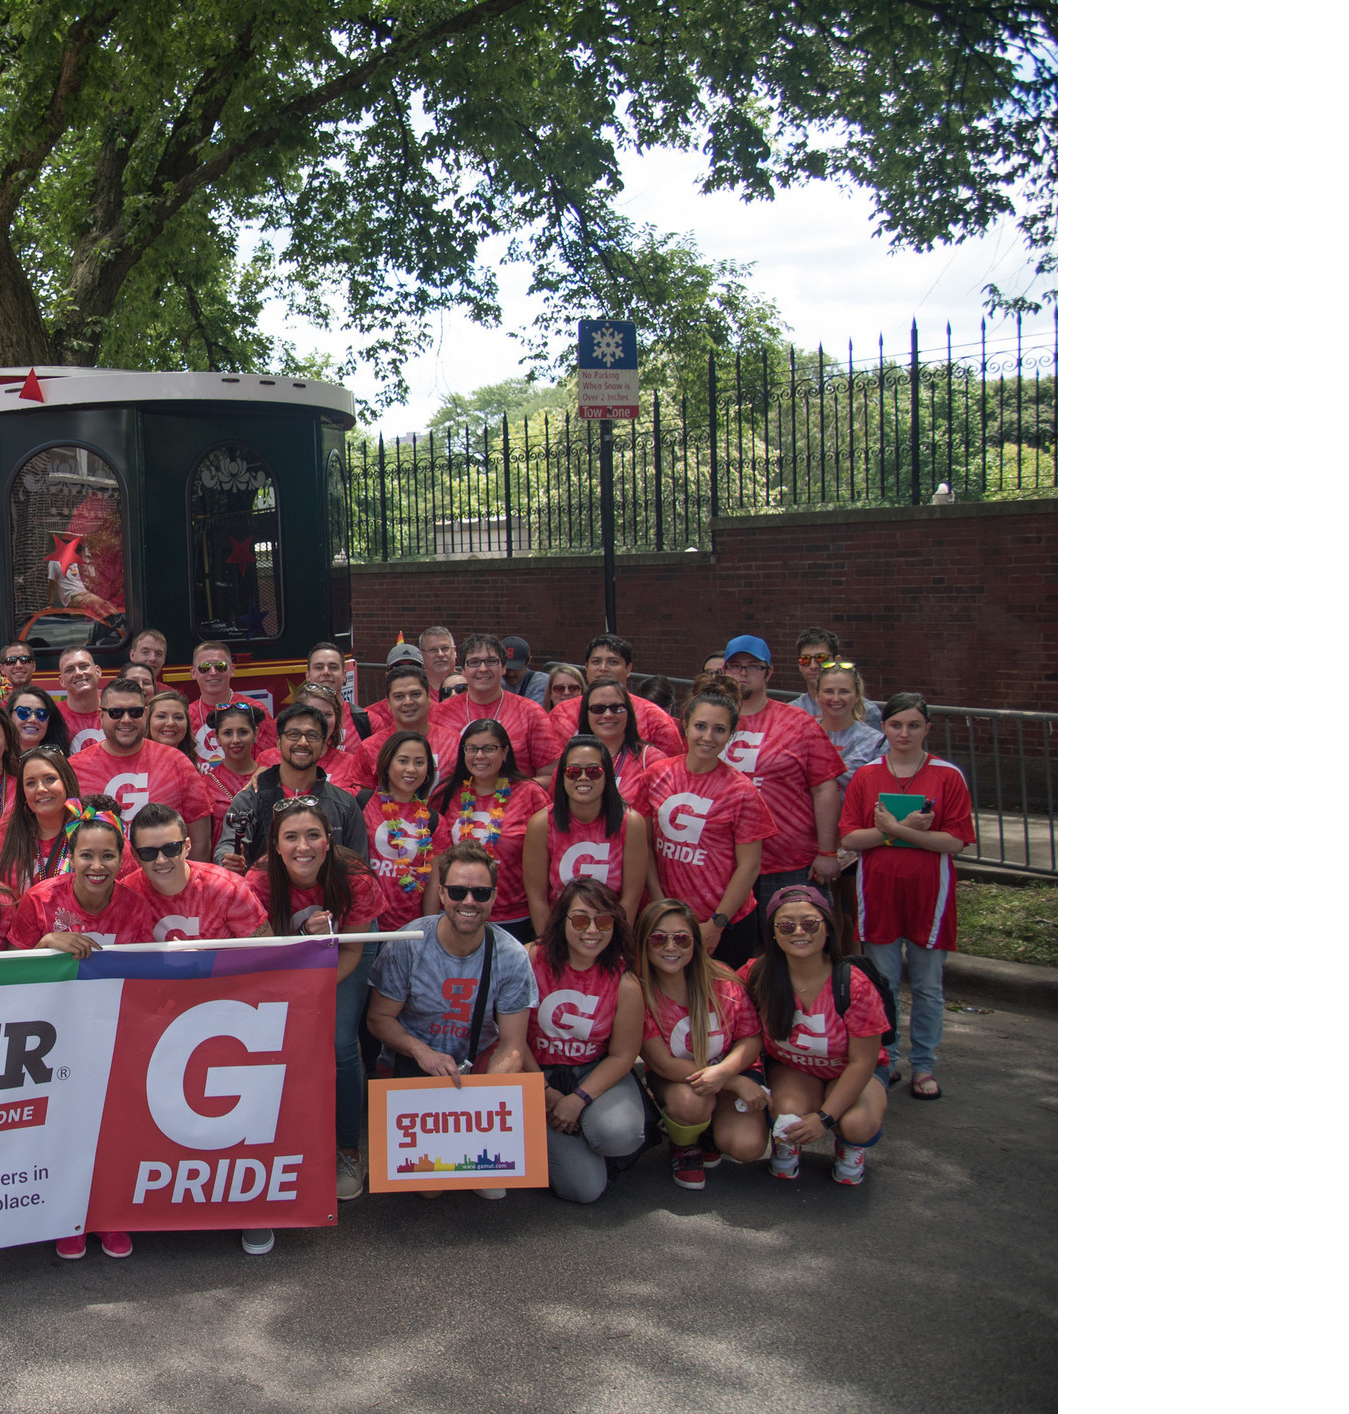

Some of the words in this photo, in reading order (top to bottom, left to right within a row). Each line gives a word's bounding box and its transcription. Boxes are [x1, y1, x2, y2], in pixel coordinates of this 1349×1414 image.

[582, 371, 592, 379] No
[594, 371, 620, 381] Parking
[582, 382, 602, 390] When
[604, 382, 623, 390] Snow
[624, 382, 631, 390] is
[582, 393, 599, 401] Over
[607, 393, 629, 401] Inches
[582, 406, 603, 418] Tow
[606, 406, 631, 418] Zone
[717, 731, 765, 773] G
[103, 772, 150, 822] G
[658, 792, 714, 845] G
[558, 841, 610, 888] G
[656, 838, 707, 866] PRIDE
[537, 989, 600, 1041] G
[775, 1010, 828, 1058] G
[536, 1036, 597, 1057] PRIDE
[146, 999, 289, 1151] G
[395, 1101, 513, 1149] gamut
[32, 1165, 50, 1182] in
[132, 1154, 304, 1204] PRIDE
[462, 1162, 508, 1170] www.gamut.com
